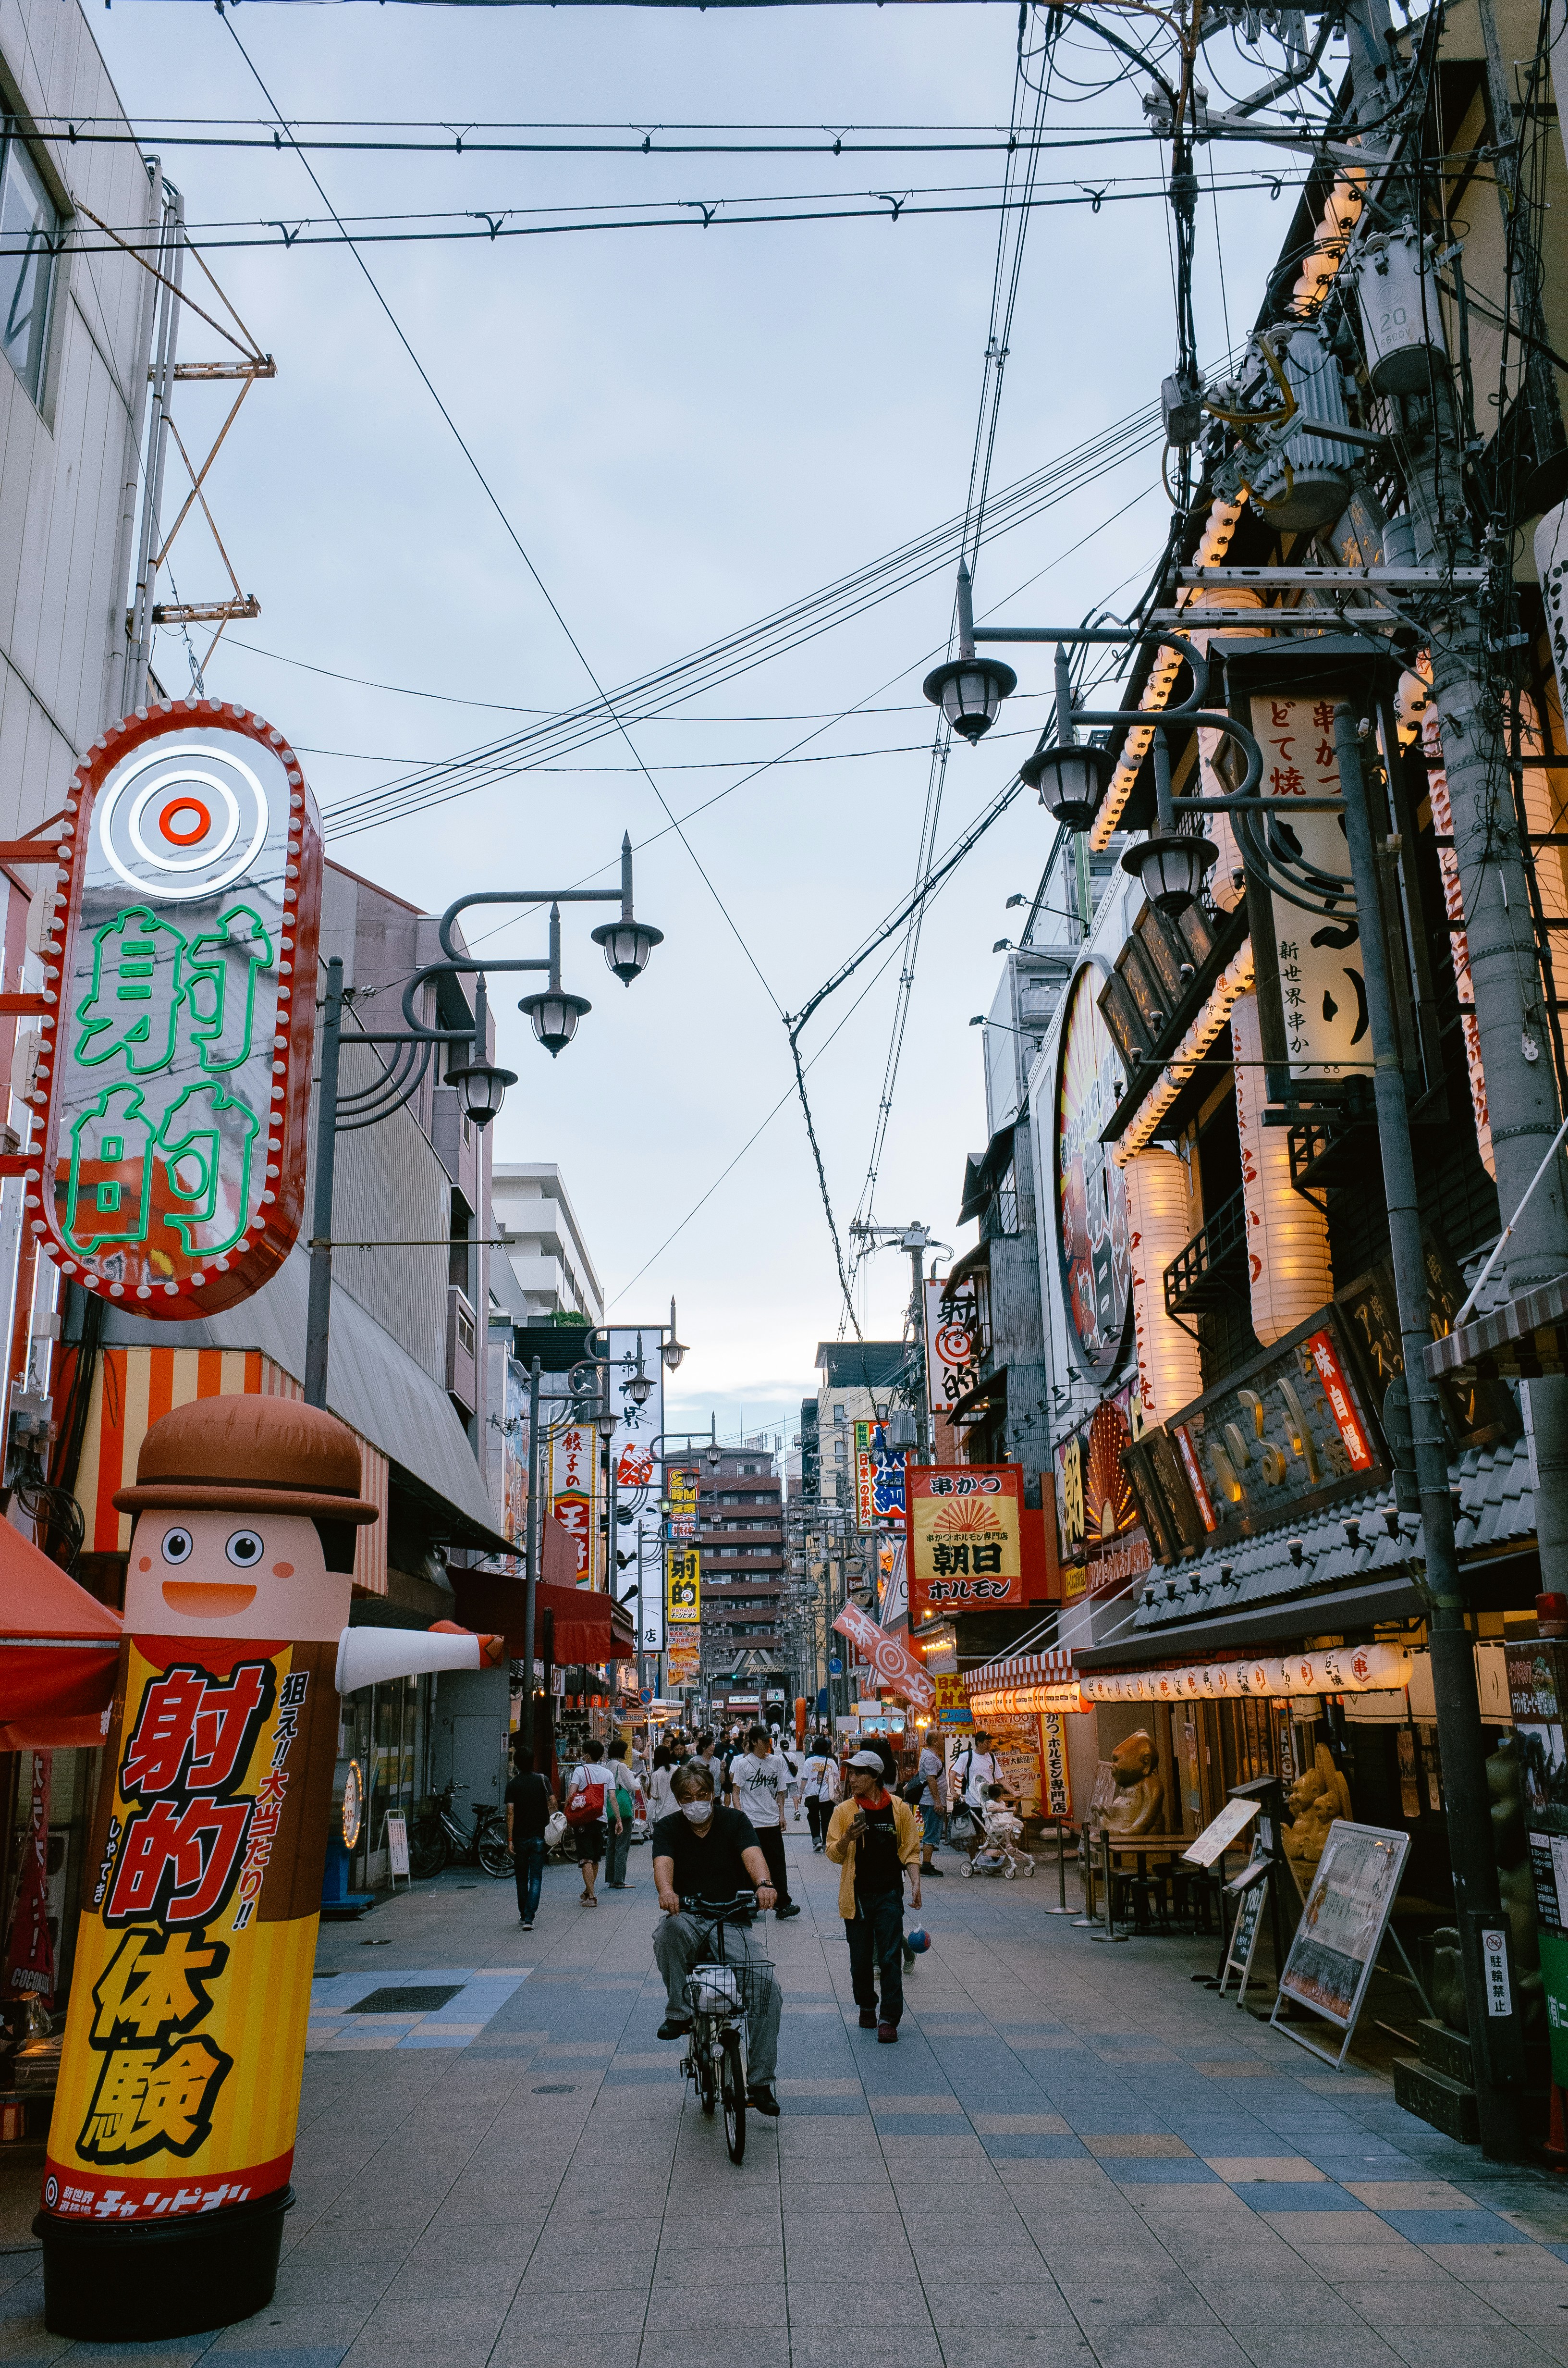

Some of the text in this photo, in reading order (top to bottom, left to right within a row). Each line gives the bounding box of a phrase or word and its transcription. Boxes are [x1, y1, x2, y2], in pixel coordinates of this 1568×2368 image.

[1379, 307, 1407, 333] 20
[1269, 700, 1306, 796] どて焼
[61, 903, 274, 1258] 射的
[1313, 1343, 1366, 1462] 味自慢
[562, 1431, 583, 1488] 餃子の
[671, 1488, 697, 1501] 時間
[859, 1453, 871, 1528] 日本一の串かつ
[930, 1477, 1002, 1497] 串かつ
[671, 1553, 697, 1607] 射的
[932, 1542, 1003, 1577] 朝日
[929, 1577, 1011, 1602] ホルモン
[1325, 1654, 1345, 1687] どて焼
[1353, 1658, 1368, 1677] 串
[93, 1818, 121, 1905] しゃてき
[1490, 1955, 1507, 2012] 駐輪禁止
[62, 2185, 95, 2205] 新世界
